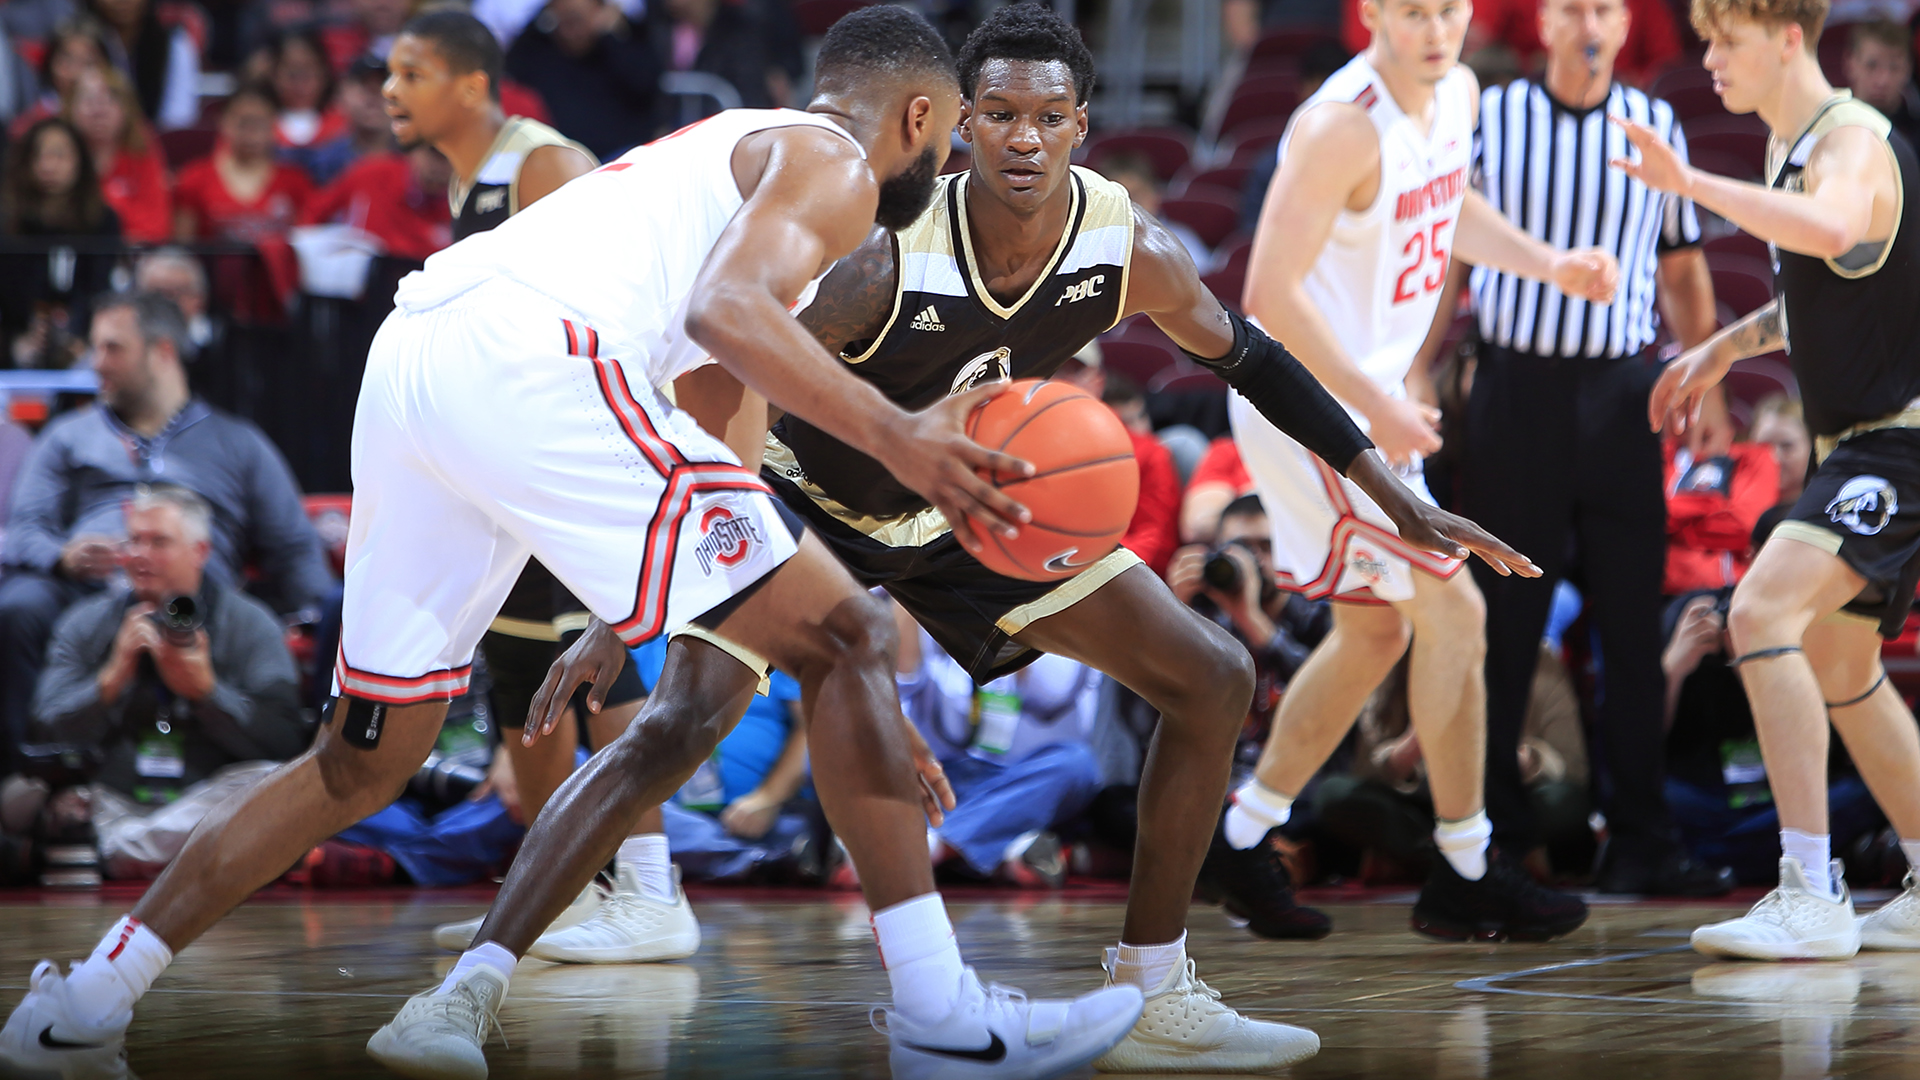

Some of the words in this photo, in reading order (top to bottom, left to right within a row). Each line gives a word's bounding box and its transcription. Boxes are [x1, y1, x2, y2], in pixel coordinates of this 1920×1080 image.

[1393, 218, 1452, 304] 25
[1054, 274, 1105, 307] PBC
[909, 320, 946, 332] adidas
